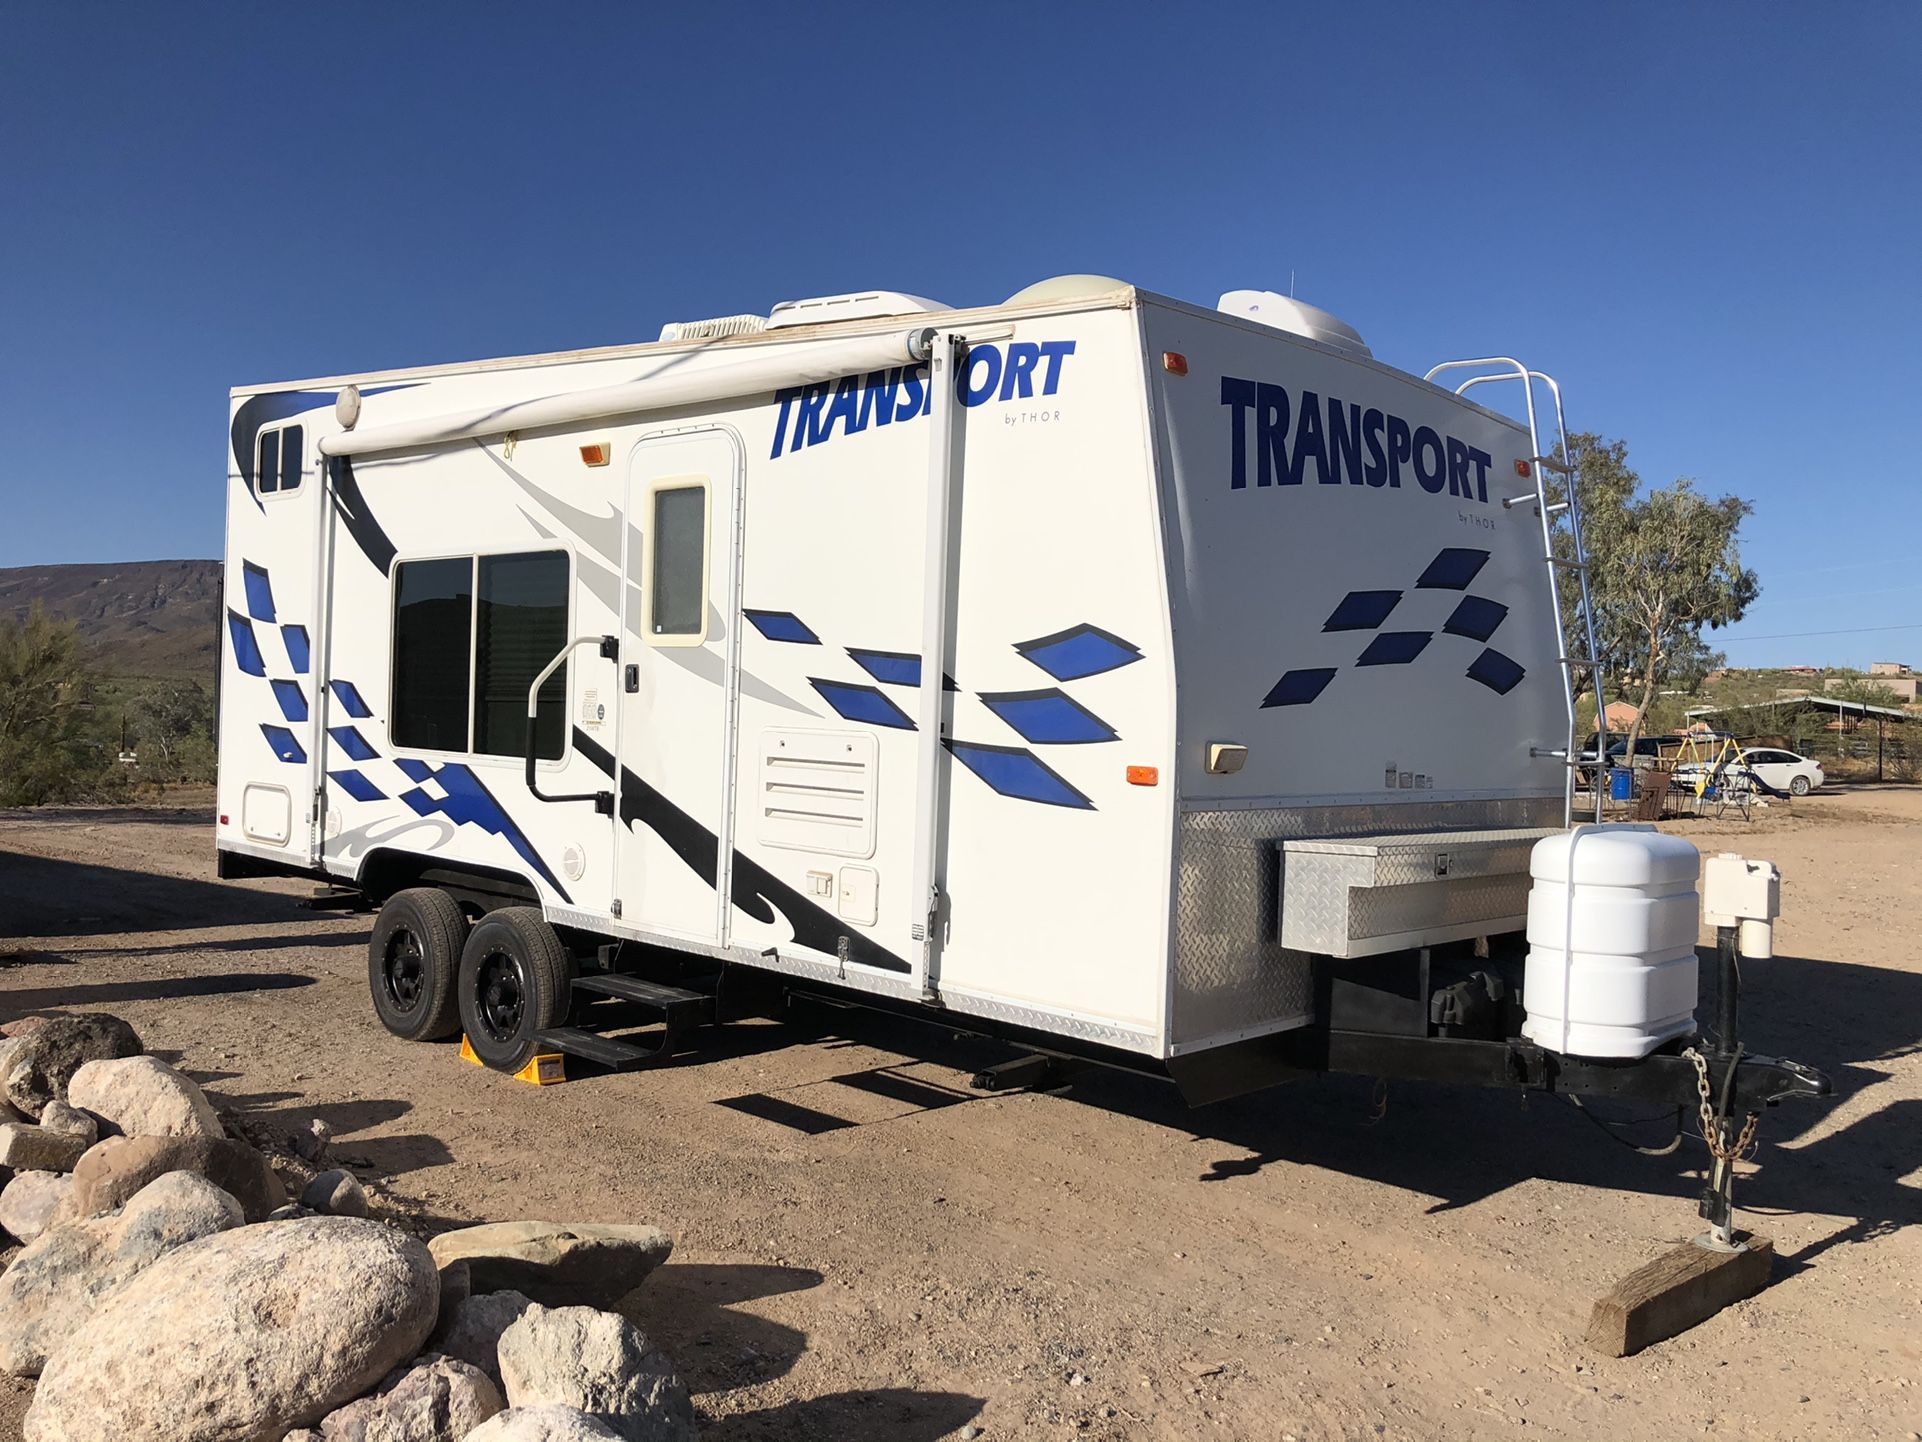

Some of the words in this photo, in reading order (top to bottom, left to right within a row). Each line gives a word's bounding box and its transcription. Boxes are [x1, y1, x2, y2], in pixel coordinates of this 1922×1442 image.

[1005, 412, 1017, 427] by
[1021, 410, 1061, 423] THOR
[1221, 376, 1492, 503] TRANSPORT
